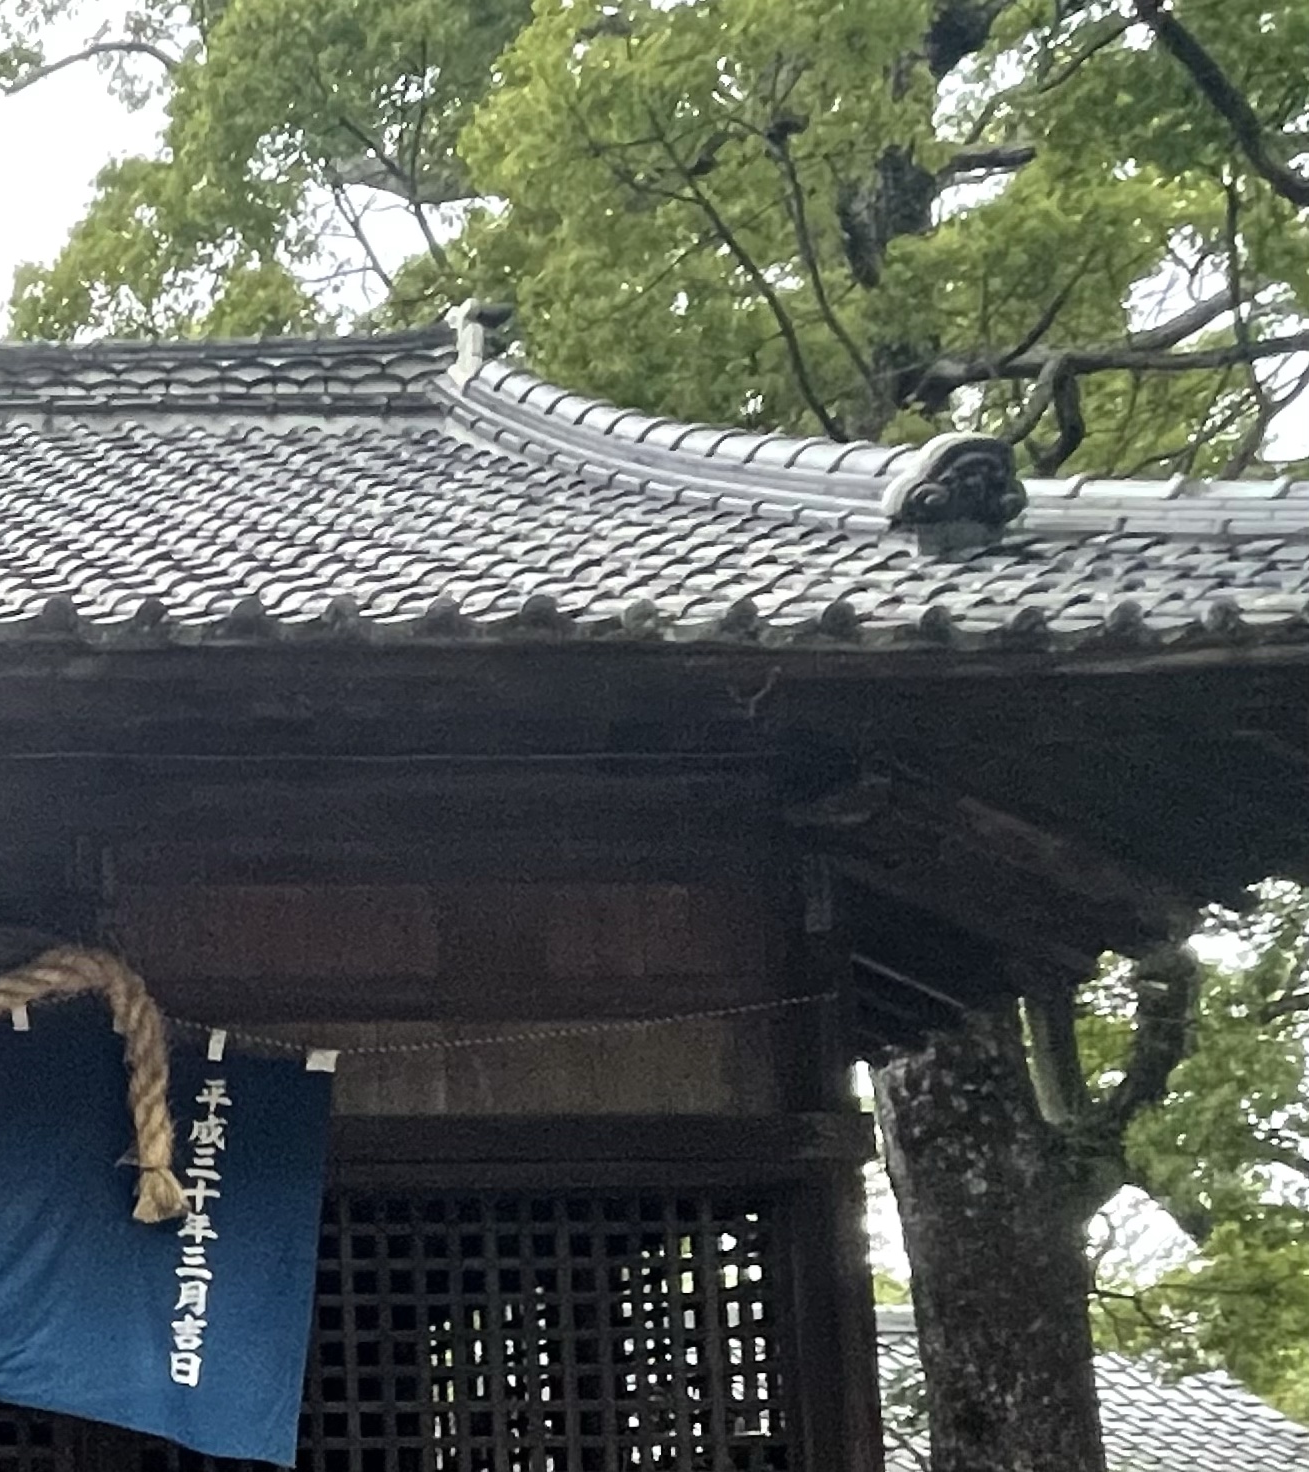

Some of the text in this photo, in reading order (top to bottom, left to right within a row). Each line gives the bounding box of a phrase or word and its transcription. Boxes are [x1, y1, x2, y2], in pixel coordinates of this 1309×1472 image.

[170, 1079, 233, 1387] 平成三十年三月吉日
